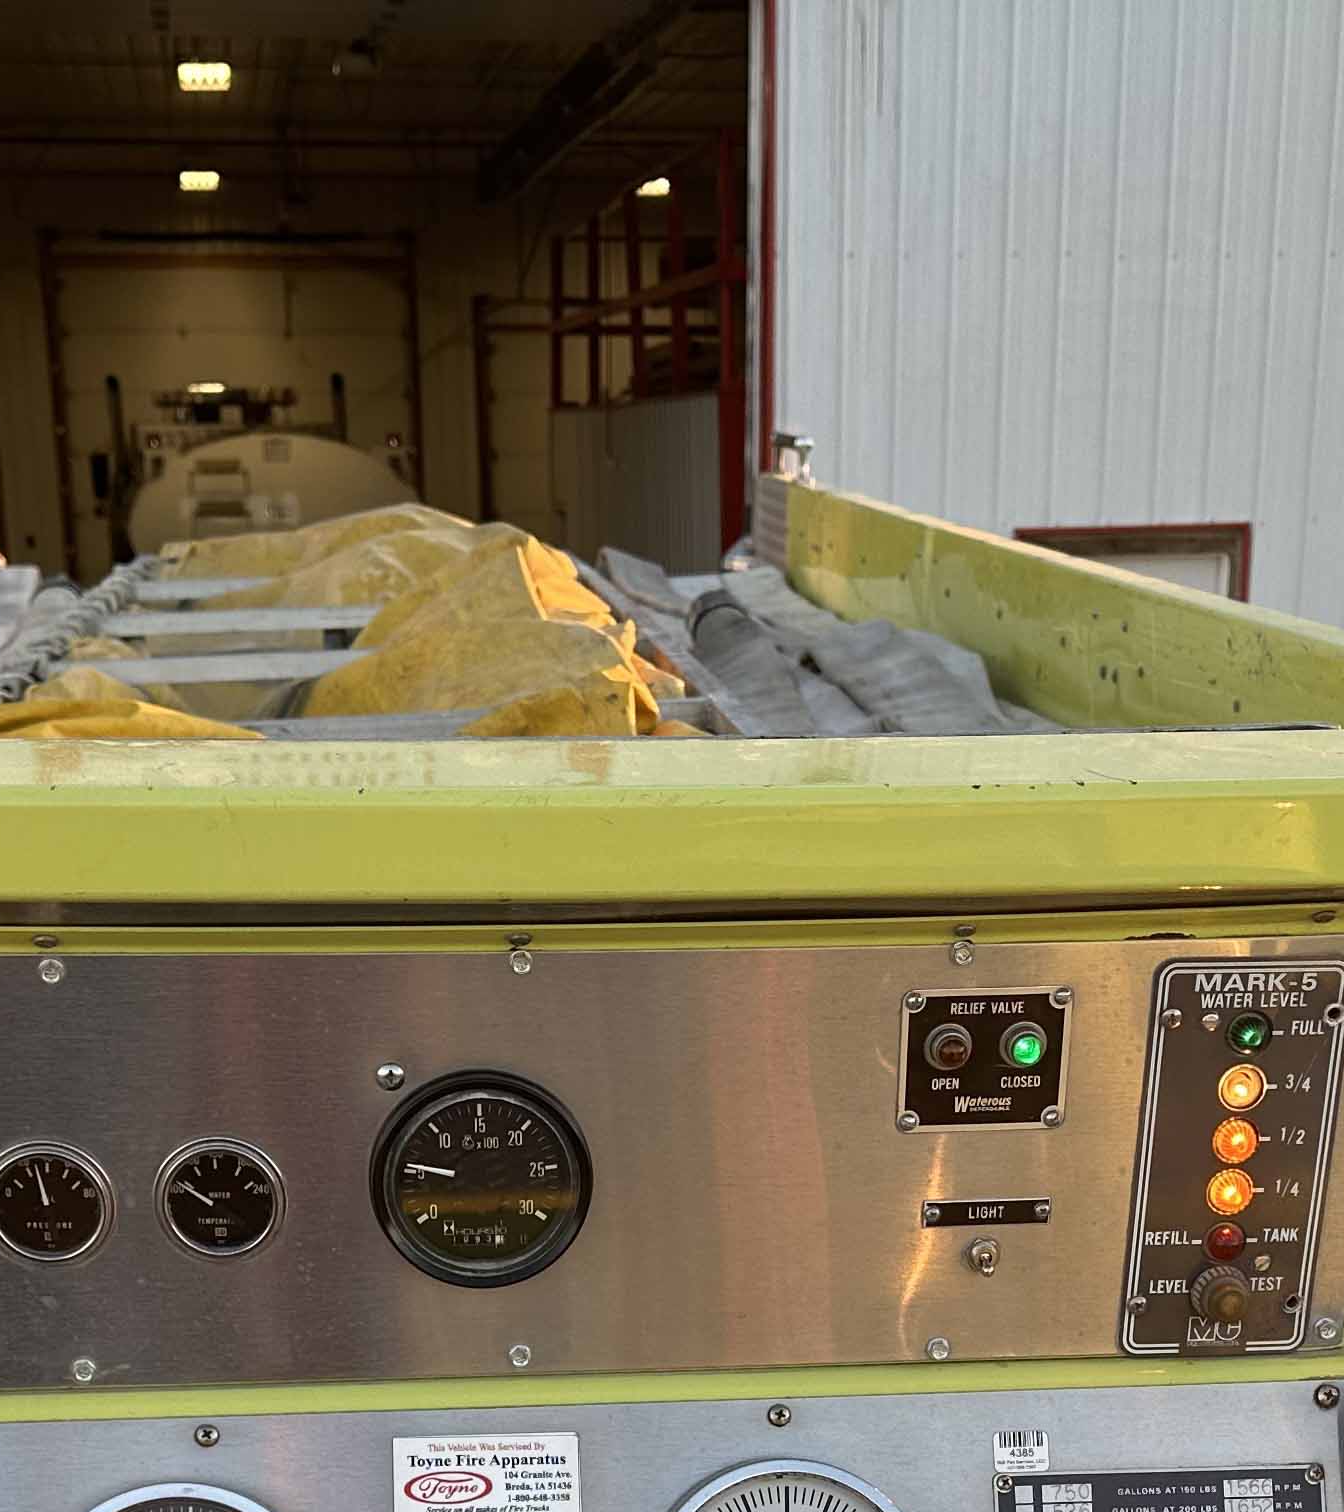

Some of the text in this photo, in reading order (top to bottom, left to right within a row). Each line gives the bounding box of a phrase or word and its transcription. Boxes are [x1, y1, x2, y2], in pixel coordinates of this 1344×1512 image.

[1194, 972, 1318, 993] MARK-5
[950, 1001, 1025, 1015] RELIEF VALVE
[1200, 991, 1309, 1009] WATER LEVEL
[1291, 1020, 1326, 1036] FULL
[931, 1078, 960, 1091] OPEN
[1000, 1075, 1041, 1089] CLOSED
[1285, 1073, 1312, 1093] 3/4
[954, 1095, 1013, 1113] Waterous
[474, 1117, 486, 1133] 15
[439, 1133, 451, 1149] 10
[508, 1130, 523, 1146] 20
[1280, 1126, 1306, 1145] 1/2
[529, 1161, 545, 1177] 25
[1275, 1178, 1300, 1197] 1/4
[519, 1199, 534, 1215] 30
[968, 1205, 1005, 1219] LIGHT
[1144, 1227, 1299, 1246] REFILL TANK
[1148, 1279, 1190, 1294] LEVEL
[1250, 1276, 1284, 1291] TEST
[1009, 1447, 1035, 1458] 4385
[407, 1452, 567, 1470] Toyne Fire Apparatus
[520, 1470, 554, 1480] Granite
[1117, 1487, 1161, 1496] GALLONS
